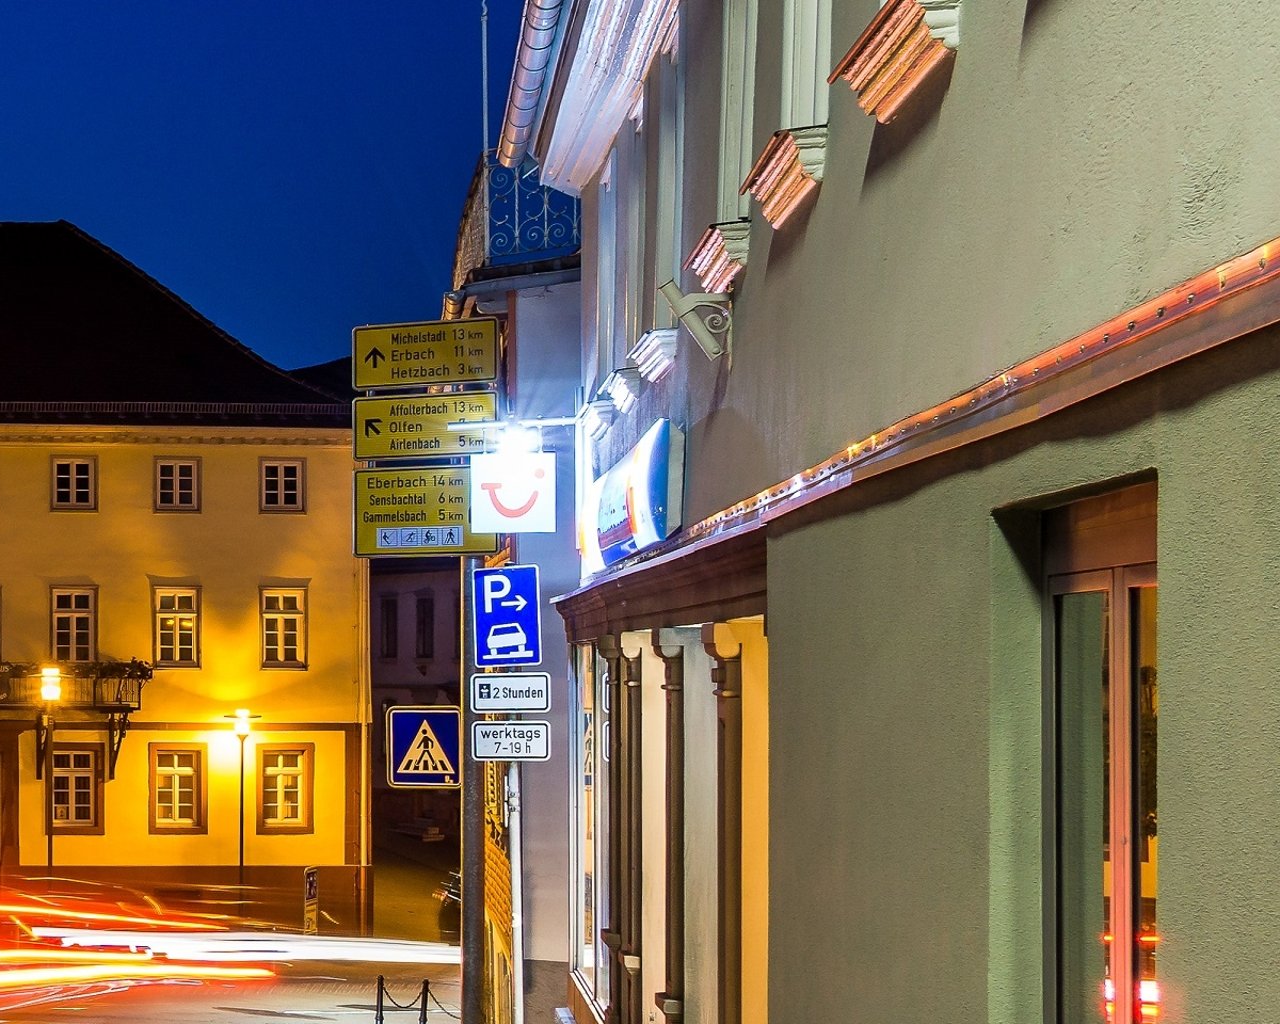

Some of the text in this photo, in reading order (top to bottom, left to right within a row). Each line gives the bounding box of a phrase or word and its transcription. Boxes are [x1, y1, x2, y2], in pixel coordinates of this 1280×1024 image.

[391, 329, 483, 345] Michelstadt 13 km
[391, 345, 483, 362] Erbach 11 km
[391, 364, 483, 379] Hetzbach 3 km
[390, 401, 484, 417] Affolterbach 13 km
[390, 421, 423, 433] Olfen
[390, 436, 483, 450] Airlenbach 5 km
[367, 475, 464, 490] Eberbach 14 km
[369, 492, 464, 506] Sensbachtal 6 km
[363, 509, 464, 524] Gammelsbach 5 km
[484, 575, 512, 613] P
[493, 685, 543, 699] 2 Stunden
[480, 728, 541, 742] werktags
[494, 742, 531, 754] 7-19 h
